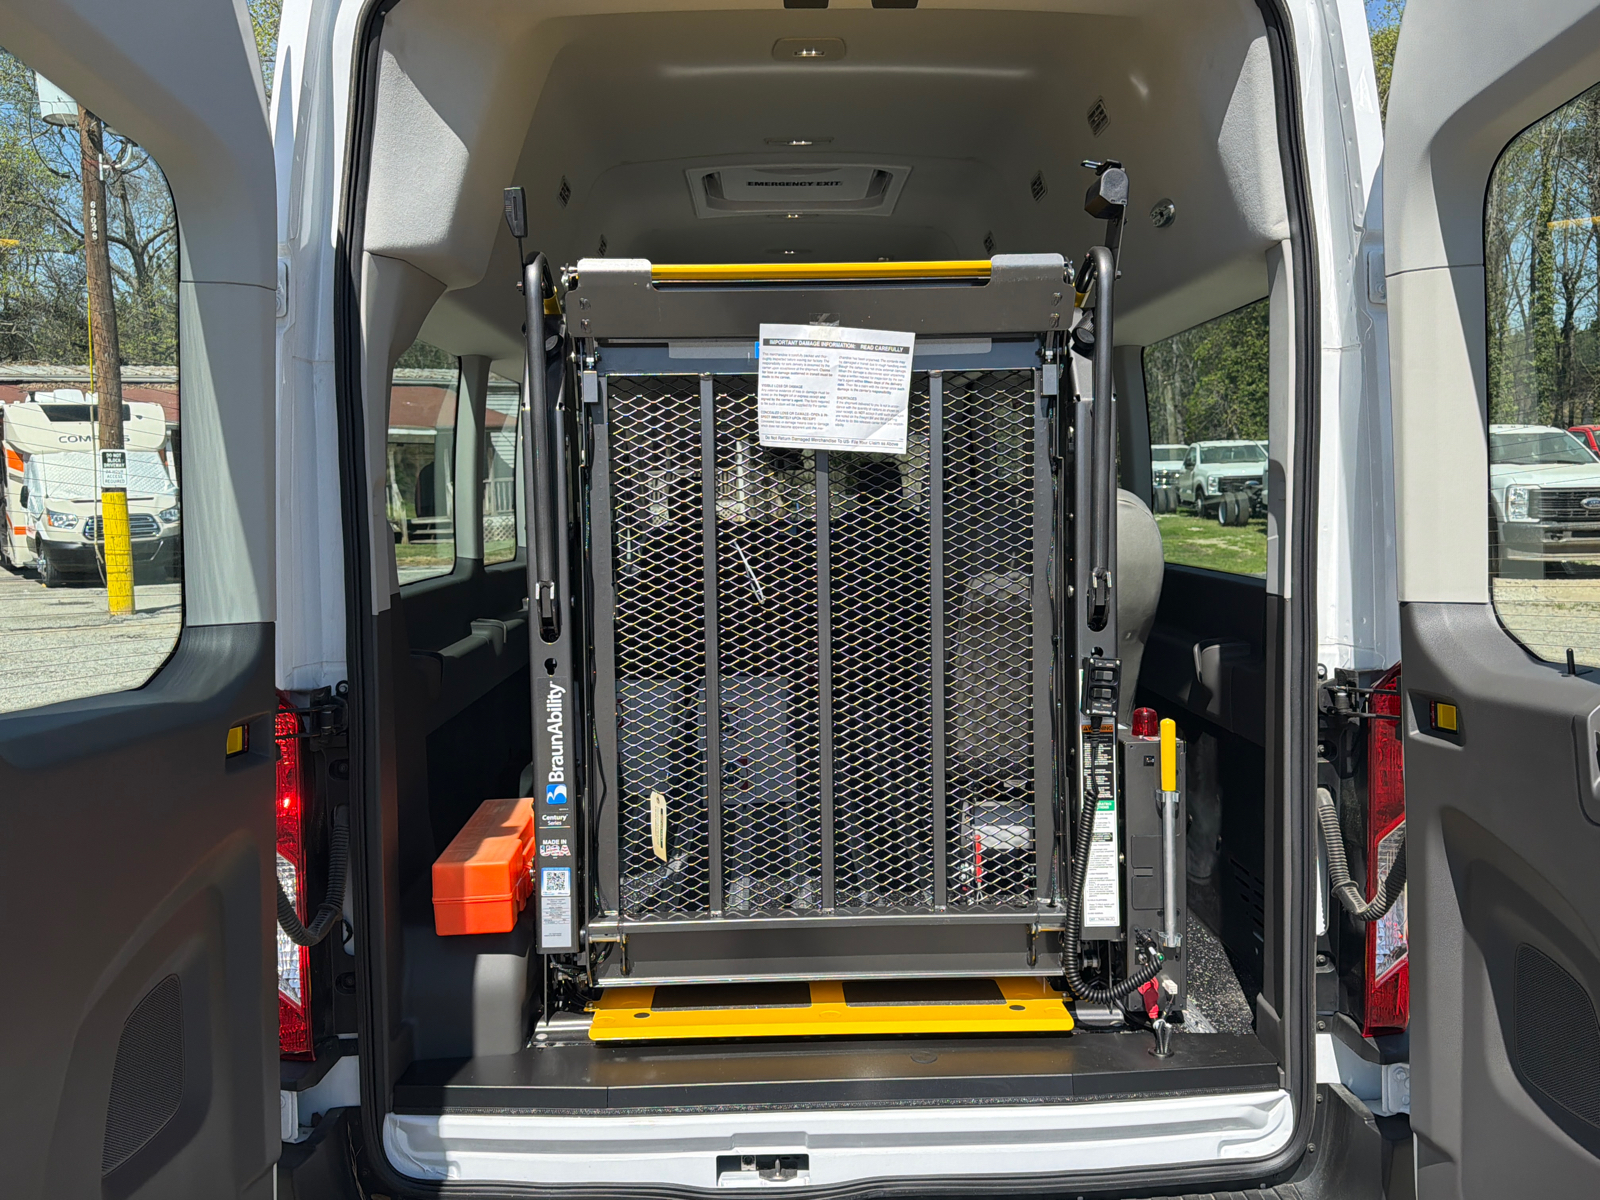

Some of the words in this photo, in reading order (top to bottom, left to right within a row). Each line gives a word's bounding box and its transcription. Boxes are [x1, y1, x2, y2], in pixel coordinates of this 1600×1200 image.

[874, 345, 904, 353] CAREFULLY
[58, 434, 131, 444] COMS
[546, 681, 567, 782] BraunAbility
[539, 844, 571, 857] USA
